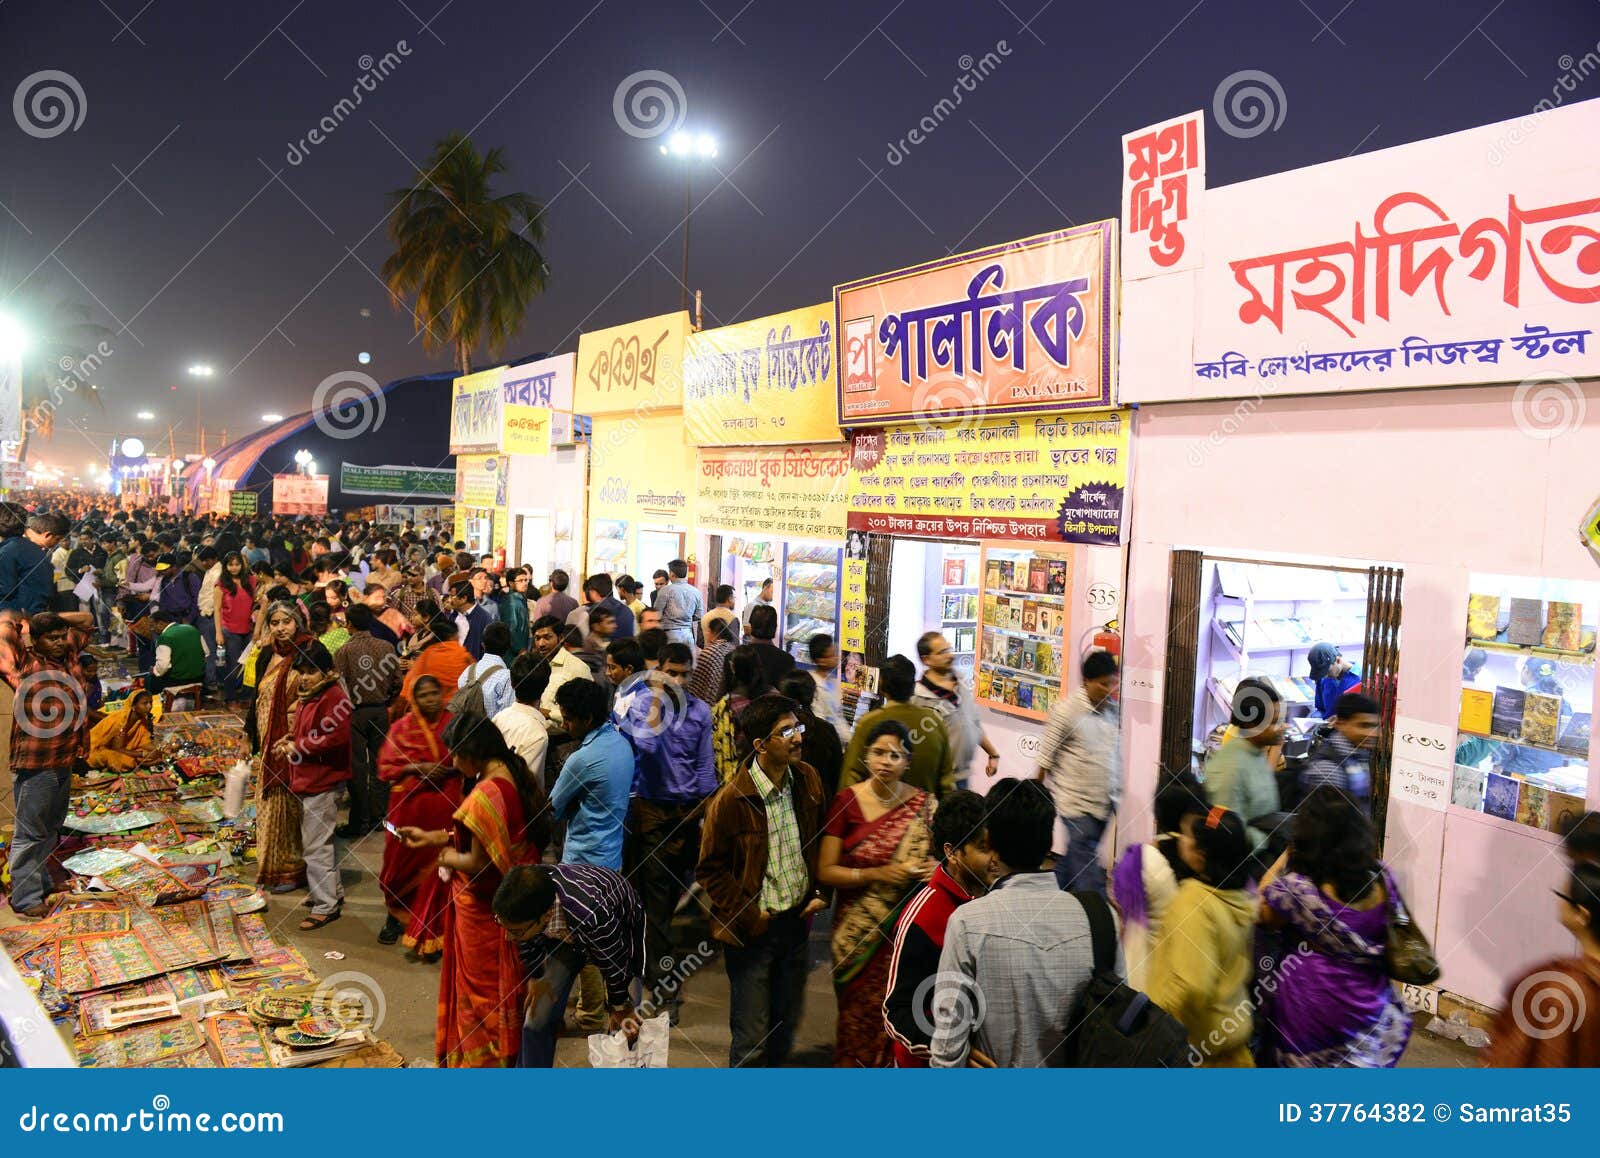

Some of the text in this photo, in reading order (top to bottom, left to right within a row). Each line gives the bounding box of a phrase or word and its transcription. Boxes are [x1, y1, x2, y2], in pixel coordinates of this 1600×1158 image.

[878, 263, 1089, 386] পাললিক
[1401, 336, 1502, 368] নিজস্ব
[1511, 323, 1592, 361] স্টল
[588, 329, 670, 393] কবিতীর্থ
[1012, 381, 1085, 397] PALALIK
[722, 417, 758, 429] কলকাতা
[702, 458, 757, 480] তারকনাথ
[1049, 448, 1089, 468] ভূতের
[868, 516, 886, 528] ২০০
[888, 515, 913, 530] টাকার
[946, 518, 969, 534] উপর
[1009, 520, 1046, 537] উপহার
[1087, 589, 1116, 607] 535
[1402, 733, 1447, 751] ৫৩৬
[1403, 983, 1432, 1011] 536
